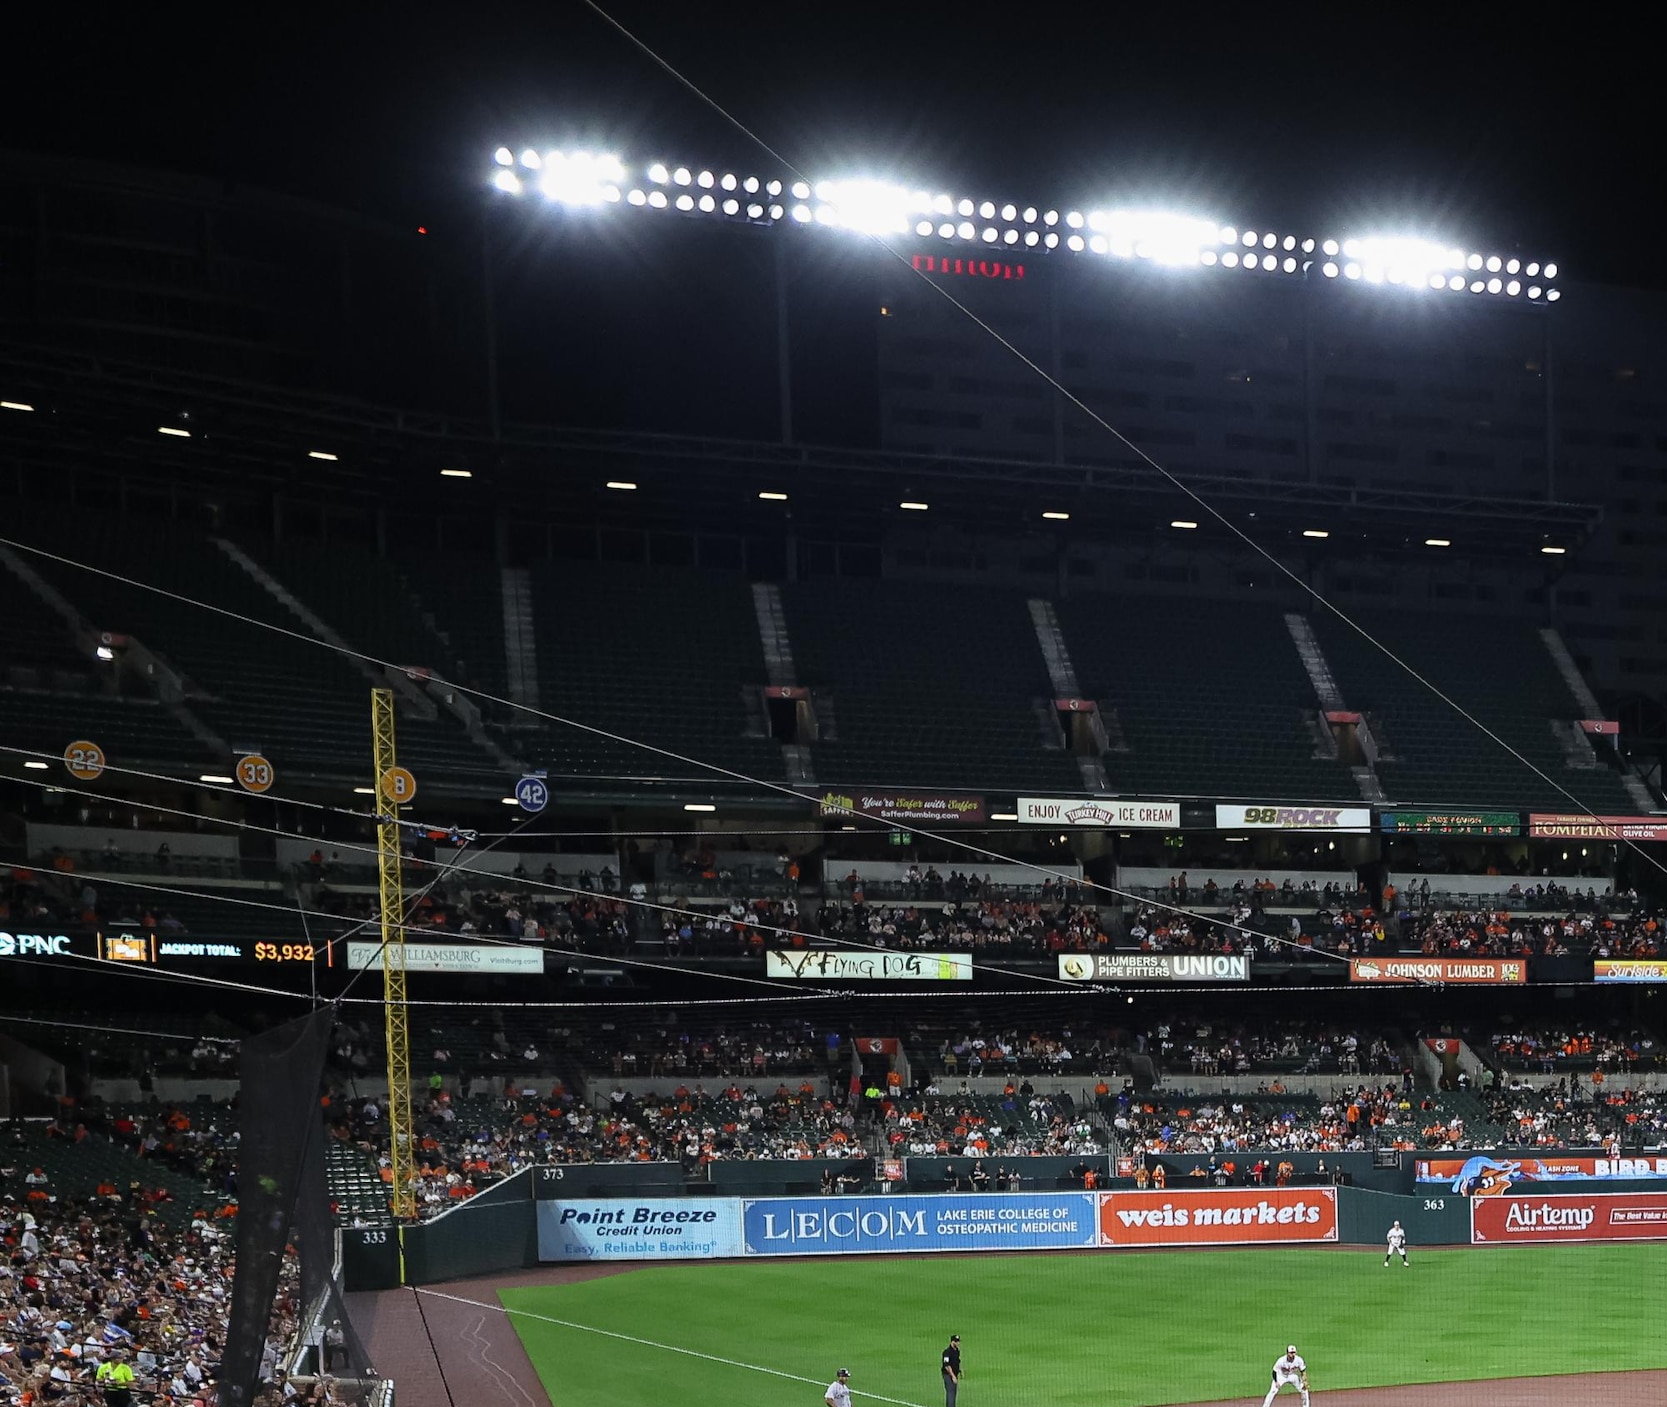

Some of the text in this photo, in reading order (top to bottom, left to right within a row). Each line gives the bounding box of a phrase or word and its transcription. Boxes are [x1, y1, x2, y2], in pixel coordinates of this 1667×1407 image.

[242, 764, 269, 784] 33
[520, 785, 544, 804] 42
[881, 810, 959, 821] SafferPlumbing.com
[1028, 805, 1173, 822] ENJOY ICE CREAM
[17, 934, 315, 962] PNC $3,932
[1098, 956, 1168, 968] PLUMBERS &
[1098, 956, 1245, 977] PIPE FITTERS UNION
[1385, 964, 1495, 978] JOHNSON LUMBER
[1607, 964, 1659, 978] Surfside
[543, 1168, 564, 1180] 373
[1594, 1159, 1651, 1177] BIRD
[1423, 1199, 1444, 1210] 363
[632, 1208, 716, 1224] Breeze
[937, 1209, 1069, 1221] LAKE ERIE COLLEGE OF
[1116, 1201, 1321, 1227] weis markets
[1506, 1203, 1594, 1231] Airtemp
[596, 1225, 682, 1236] Credit Union
[937, 1220, 1078, 1235] OSTEOPATHIC MEDICINE
